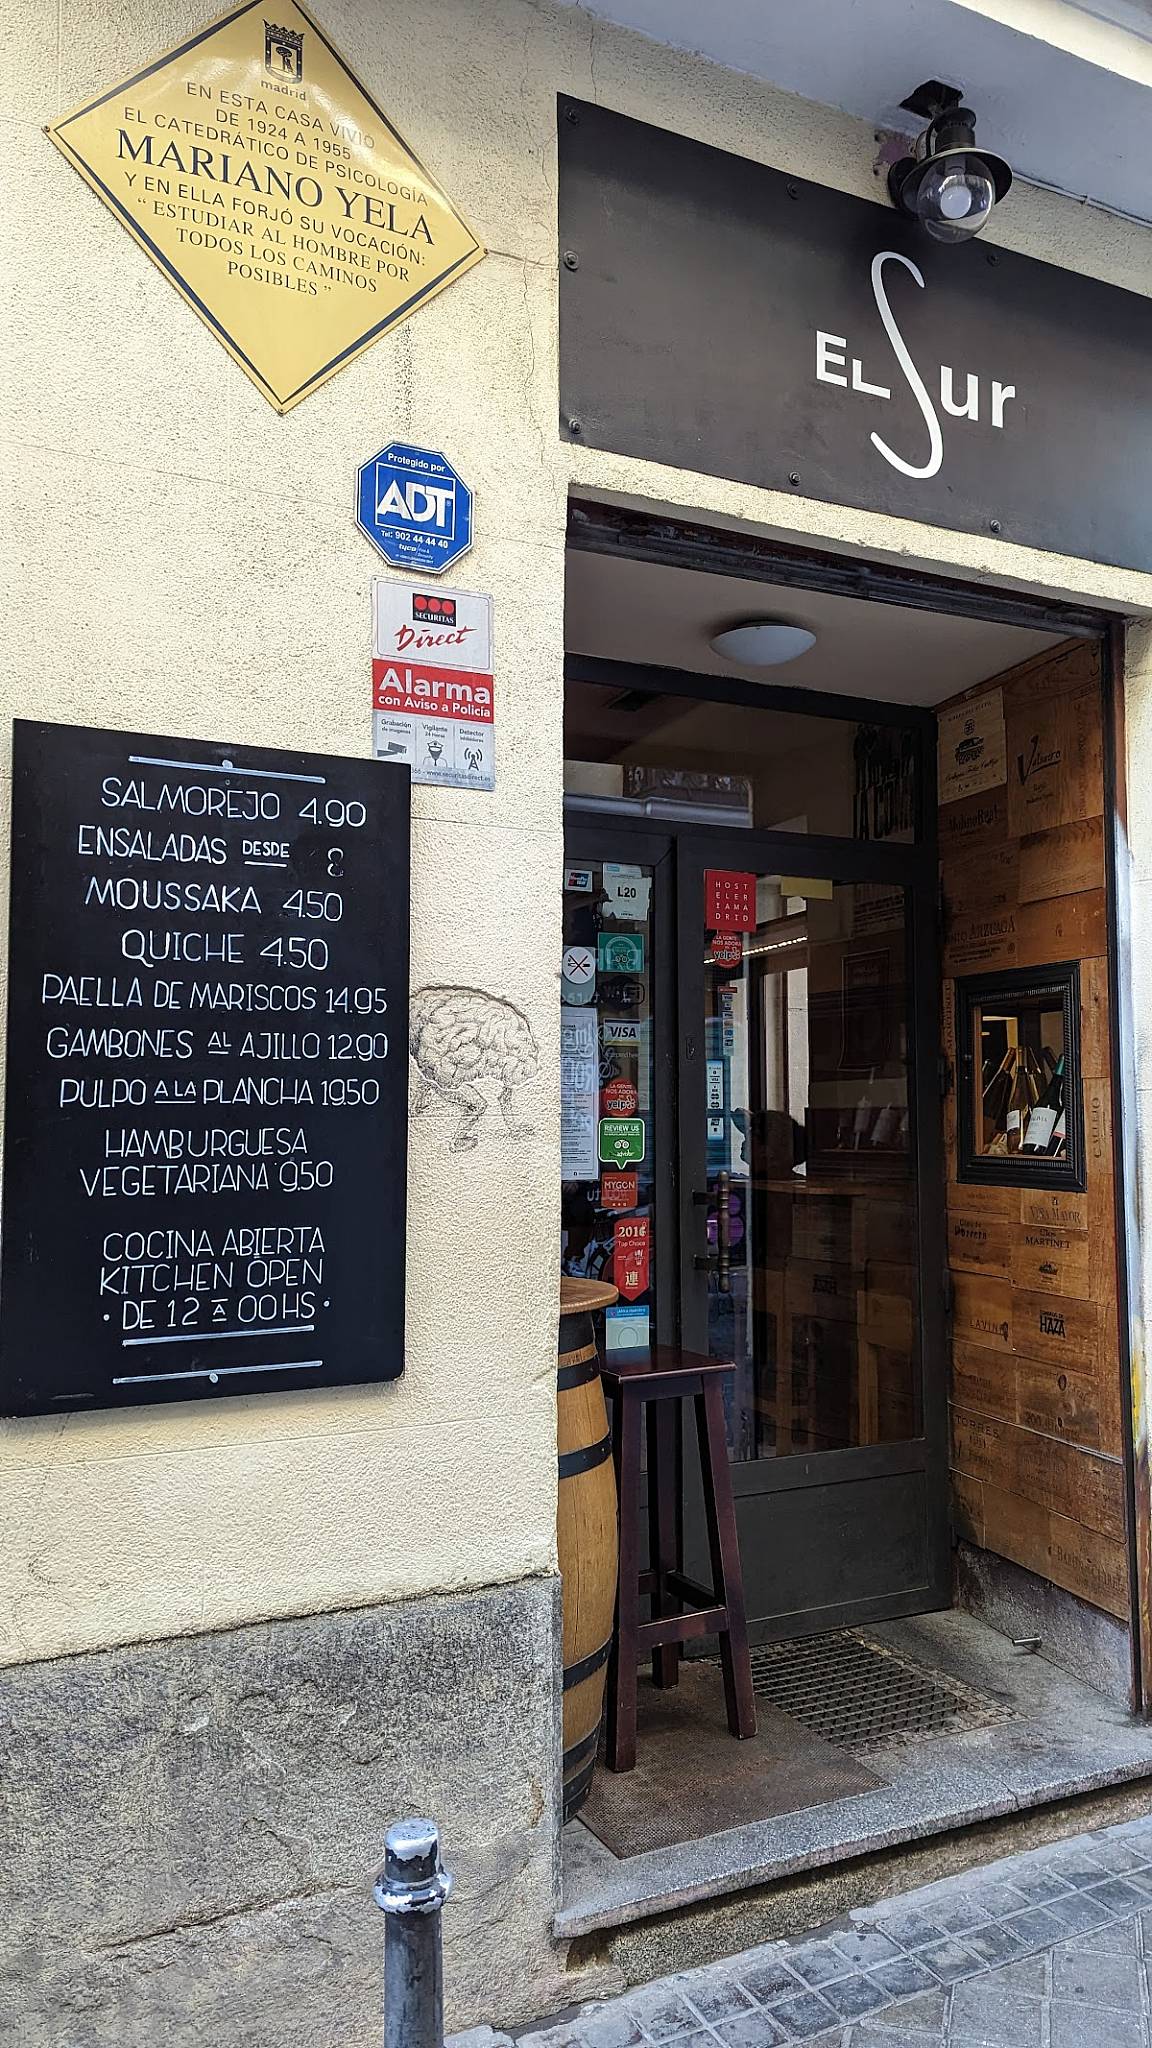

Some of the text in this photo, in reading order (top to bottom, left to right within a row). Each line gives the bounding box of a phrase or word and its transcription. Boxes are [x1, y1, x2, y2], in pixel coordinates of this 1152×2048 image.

[187, 83, 212, 99] EN
[220, 90, 268, 115] ESTA
[275, 106, 324, 133] CASA
[260, 79, 306, 101] madrid
[216, 110, 352, 160] DE 1924 A 1955
[124, 106, 428, 206] EL CATEDRÁTICO DE PSICOLOGÍA
[116, 129, 435, 245] MARIANO YELA
[125, 173, 426, 267] Y EN ELLA FORJÓ SU VOCACIÓN:
[153, 203, 254, 236] ESTUDIAR
[262, 225, 286, 245] AL
[293, 234, 371, 271] HOMBRE
[377, 259, 409, 282] POR
[176, 227, 377, 293] TODOS LOS CAMINOS
[228, 260, 318, 296] POSIBLES
[870, 251, 1016, 479] Sur
[387, 453, 445, 472] Protegido por
[378, 480, 454, 528] ADT
[381, 529, 448, 549] Tel: 902 44 44 40
[414, 612, 454, 624] SECURITAS
[395, 625, 477, 651] Direct
[379, 667, 490, 705] Alarma
[378, 695, 491, 718] con Aviso a Policía
[423, 724, 448, 732] Vigilante
[459, 728, 484, 737] Detector
[100, 776, 367, 828] SALMOREJO 4.90
[78, 825, 227, 865] ENSALADAS
[242, 840, 290, 858] DESDE
[85, 877, 343, 921] MOUSSAKA 4.50
[617, 886, 637, 898] L20
[121, 929, 329, 970] QUICHE 4.50
[714, 949, 732, 962] yelp
[42, 974, 388, 1014] PAELLA DE MARISCOS 14.95
[46, 1026, 388, 1060] GAMBONES AL AJILLO 12.90
[608, 1026, 637, 1038] VISA
[60, 1076, 380, 1108] PULPO A LA PLANCHA 19.50
[607, 1099, 626, 1111] yelp
[105, 1128, 307, 1159] HAMBURGUESA
[80, 1160, 334, 1197] VEGETARIANA 9.50
[103, 1226, 325, 1262] COCINA ABIERTA
[99, 1258, 323, 1296] KITCHEN OPEN
[122, 1300, 156, 1330] DE
[168, 1297, 200, 1327] 12
[213, 1304, 226, 1316] A
[1040, 1315, 1066, 1338] HAZA
